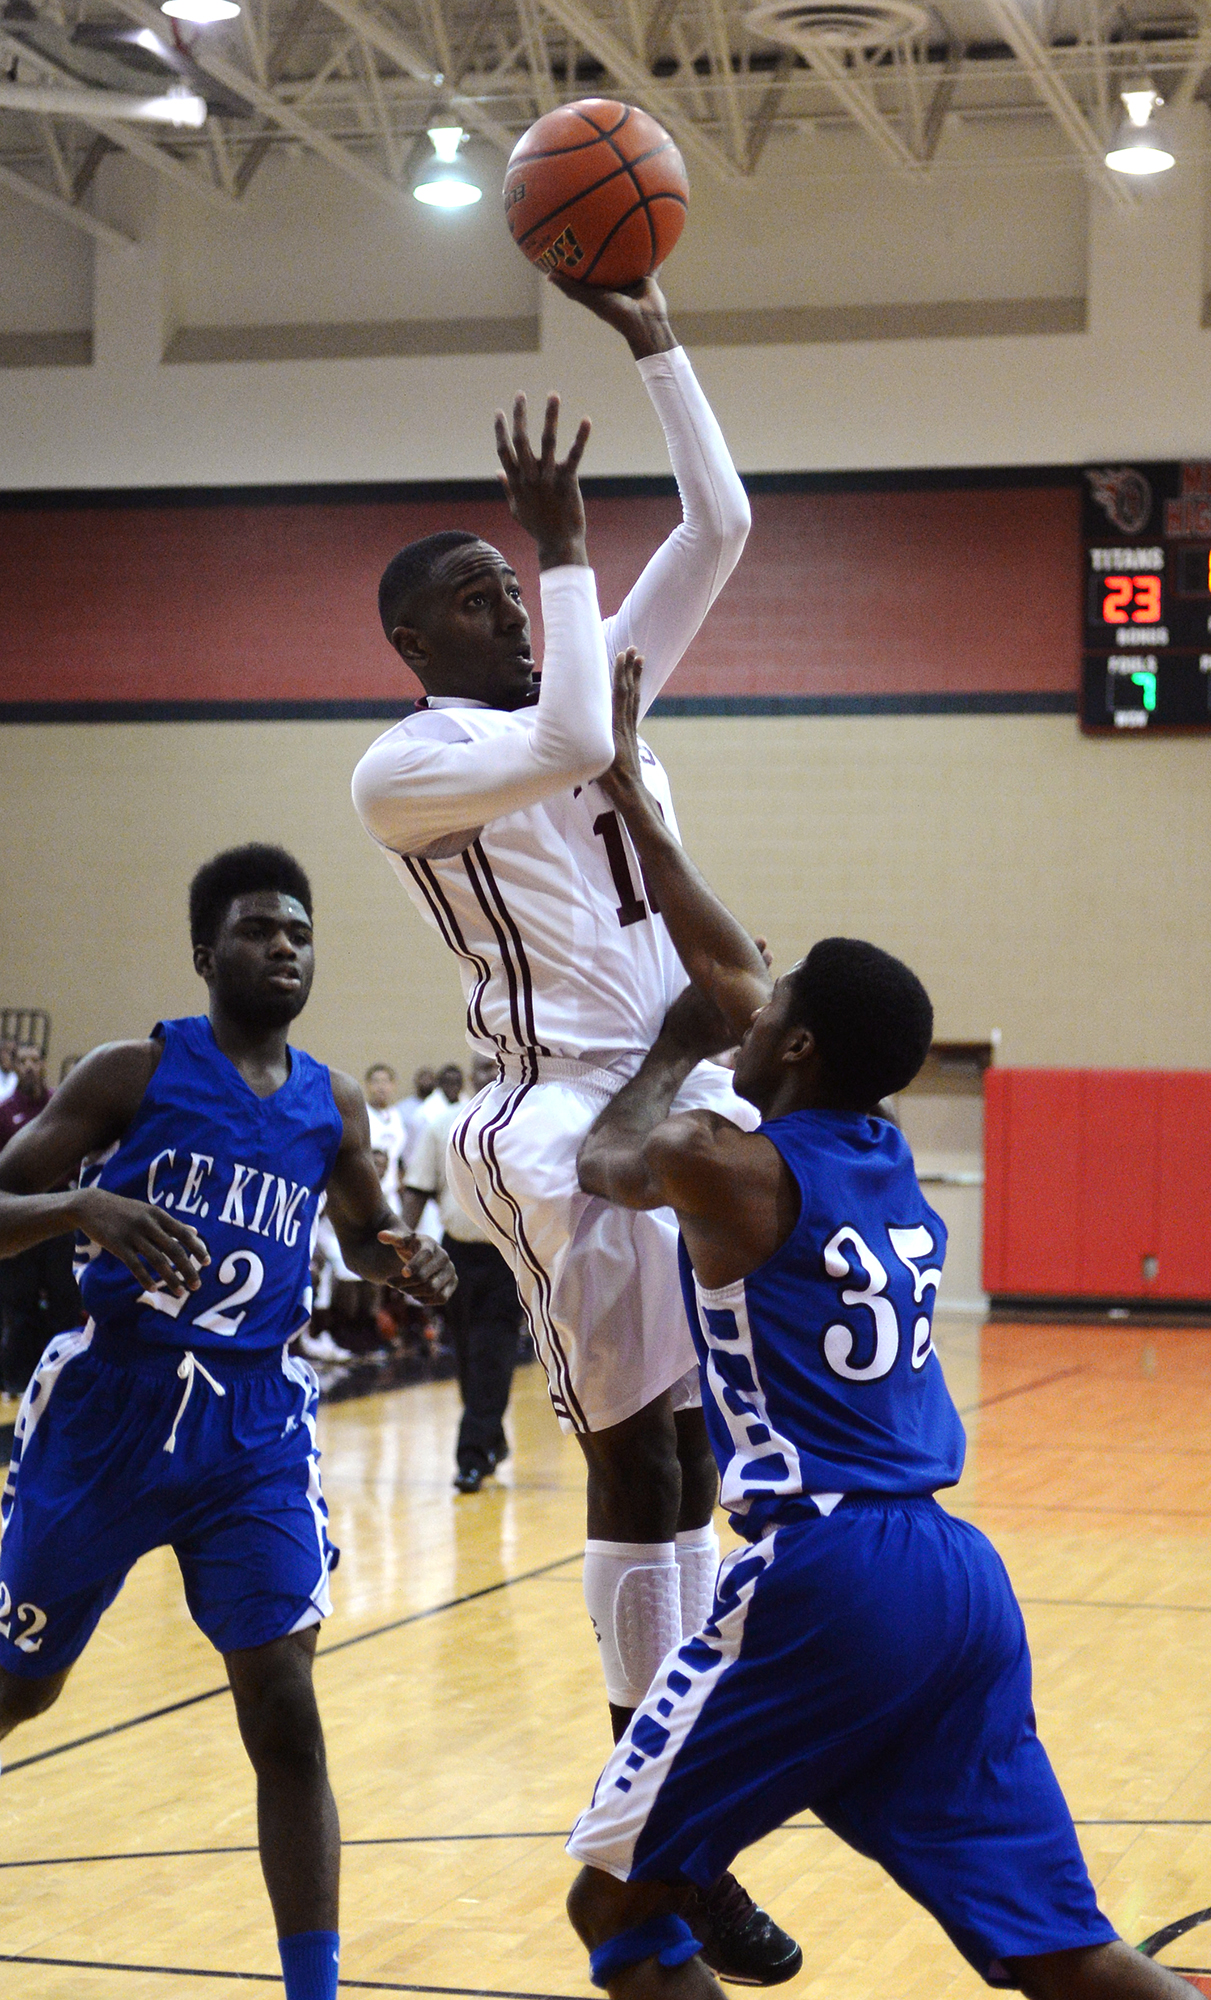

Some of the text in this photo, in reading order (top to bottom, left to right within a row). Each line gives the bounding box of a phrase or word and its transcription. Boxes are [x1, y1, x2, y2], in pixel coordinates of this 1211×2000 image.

[1090, 546, 1164, 571] TITANS
[1102, 574, 1162, 624] 23
[1131, 671, 1157, 711] 7
[593, 810, 662, 928] 1
[147, 1148, 311, 1248] C.E. KING
[823, 1225, 942, 1381] 35
